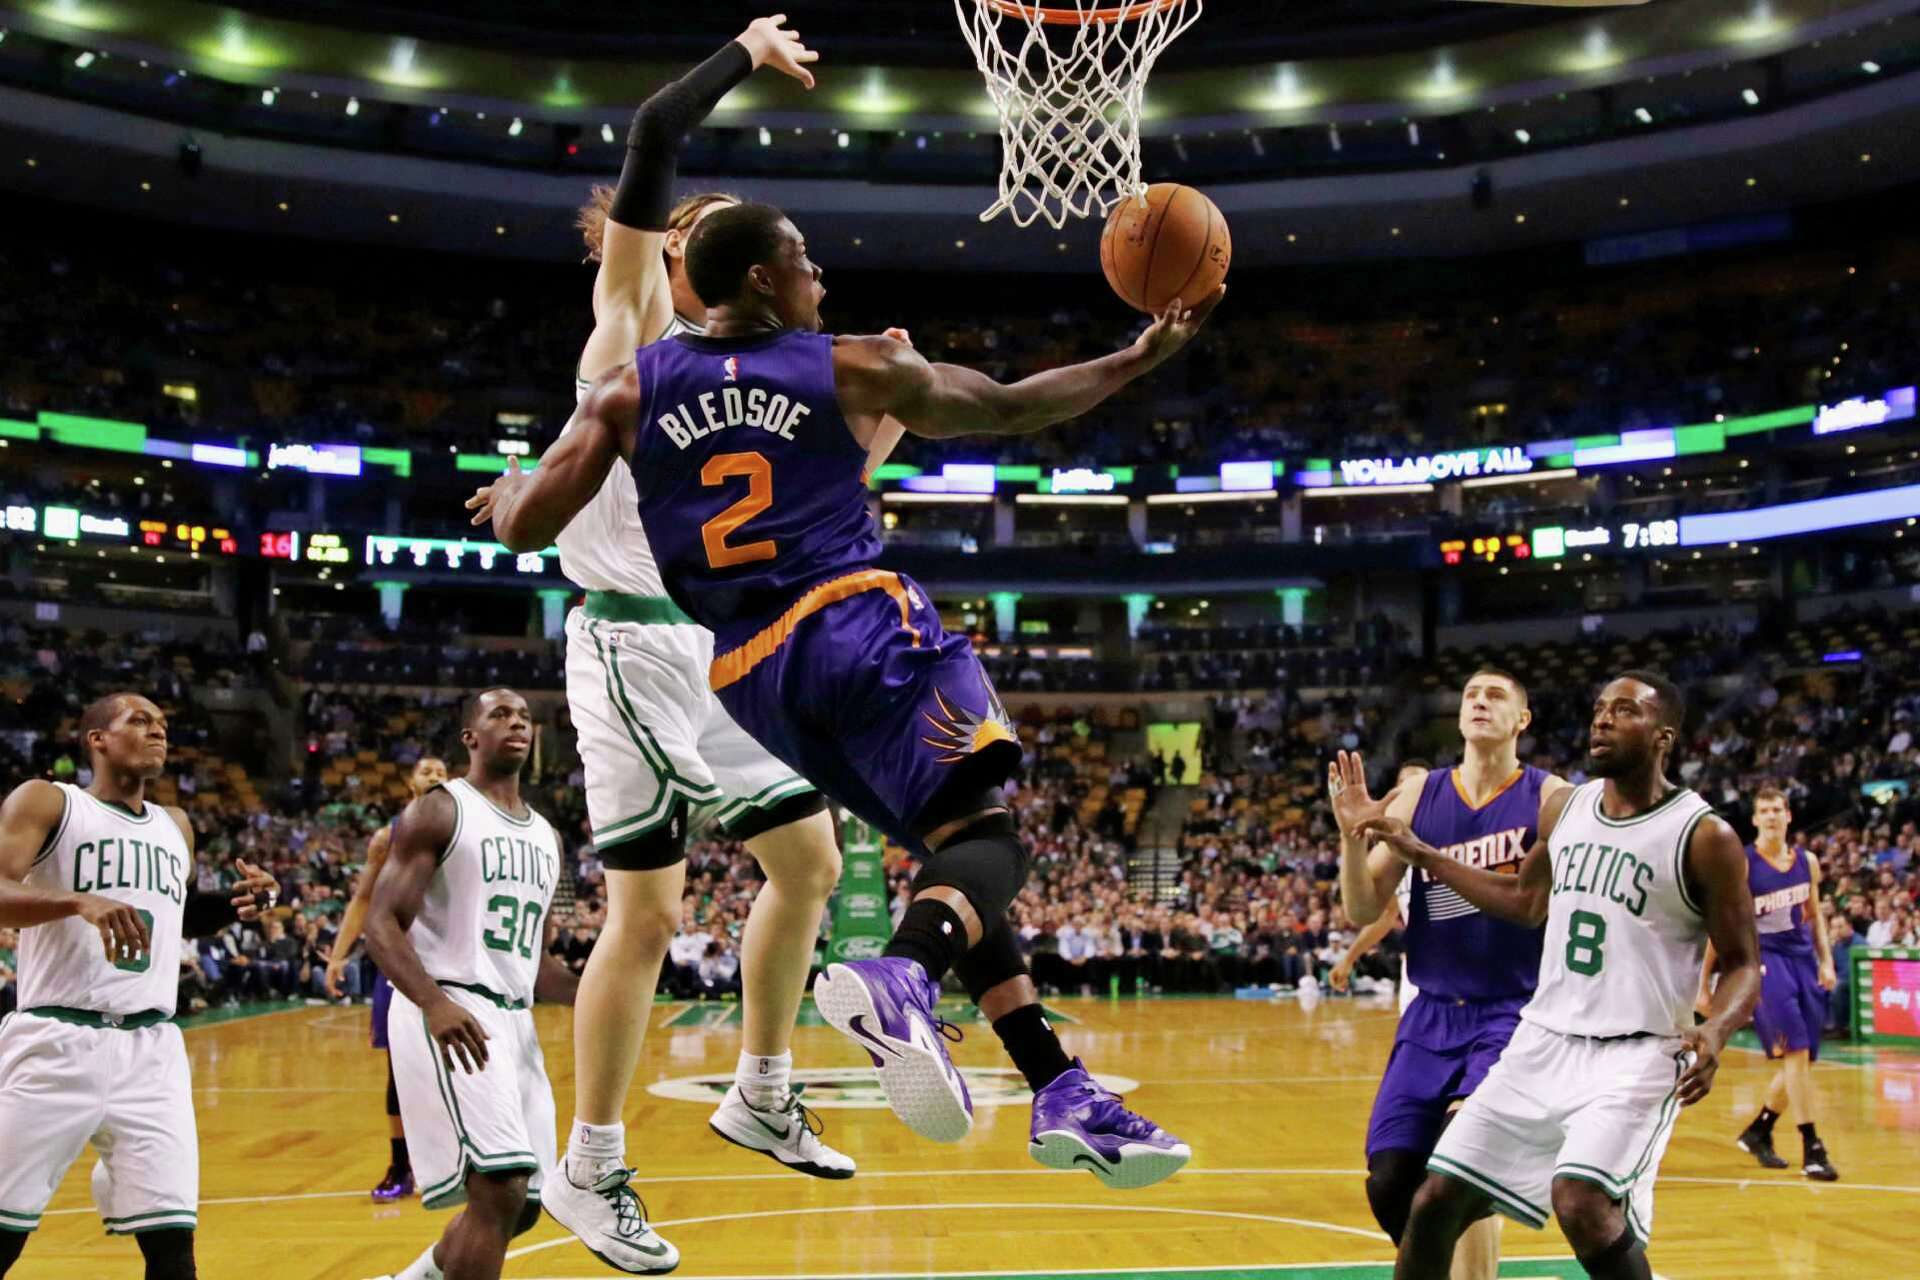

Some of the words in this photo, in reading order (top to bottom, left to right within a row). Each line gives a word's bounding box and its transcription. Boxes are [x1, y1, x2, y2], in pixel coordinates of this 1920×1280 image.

[657, 387, 811, 450] BLEDSOE
[701, 451, 777, 568] 2
[73, 838, 182, 905] CELTICS
[480, 836, 555, 897] CELTICS
[1421, 827, 1528, 882] OENIX
[1553, 842, 1655, 917] CELTICS
[483, 894, 543, 960] 30
[1566, 909, 1607, 977] 8
